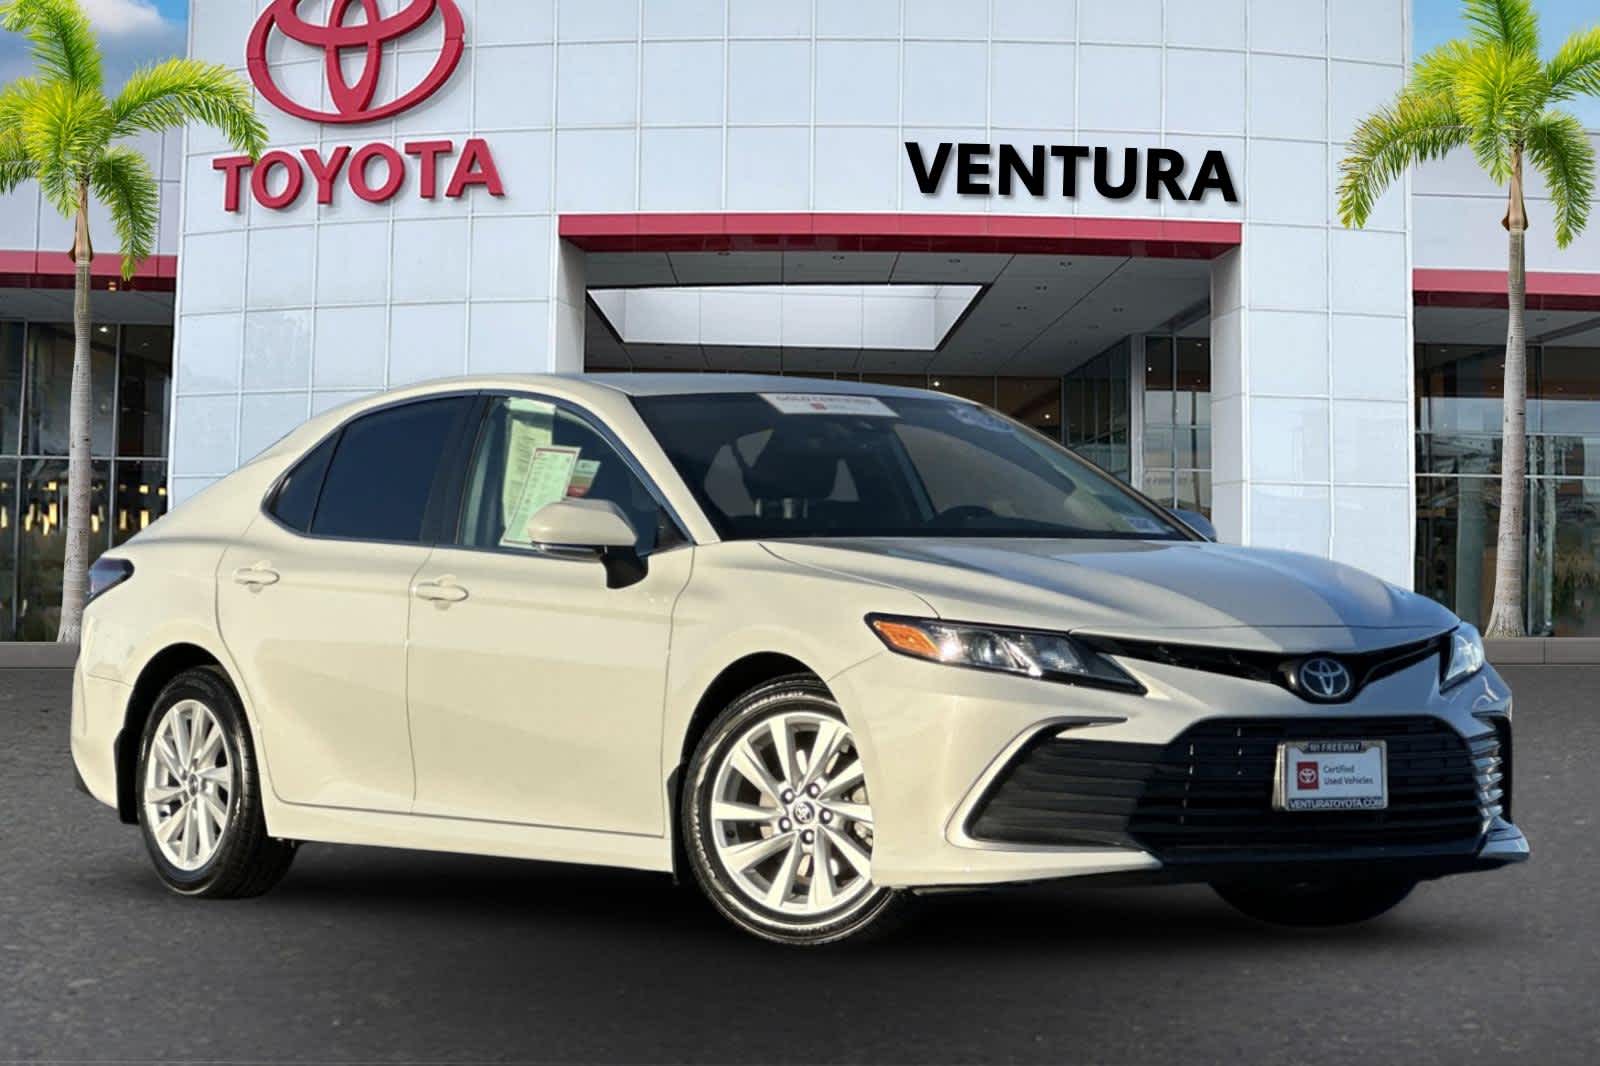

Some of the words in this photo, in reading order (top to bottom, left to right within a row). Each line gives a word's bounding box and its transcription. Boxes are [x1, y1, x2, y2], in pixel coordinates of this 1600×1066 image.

[212, 138, 505, 212] TOYOTA
[904, 141, 1239, 202] VENTURA
[1321, 743, 1360, 752] FREEWAY
[1323, 764, 1355, 774] Certified
[1323, 776, 1343, 785] Used
[1344, 776, 1374, 785] Vehicles
[1289, 798, 1383, 809] VENTURATOYOTA.COM
